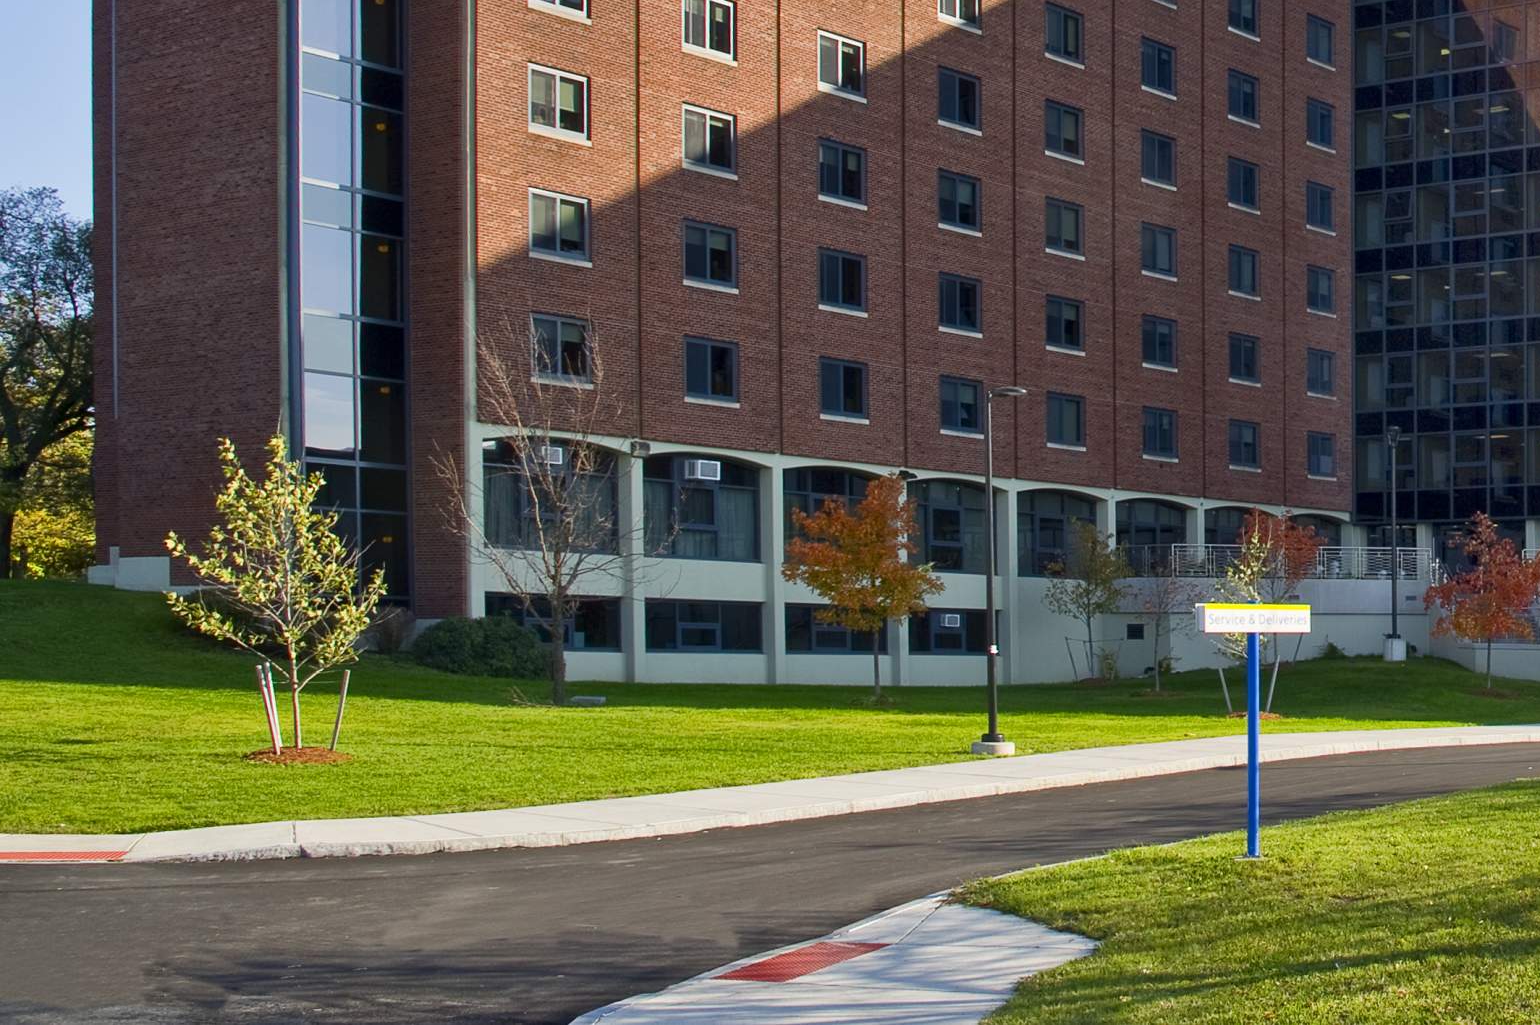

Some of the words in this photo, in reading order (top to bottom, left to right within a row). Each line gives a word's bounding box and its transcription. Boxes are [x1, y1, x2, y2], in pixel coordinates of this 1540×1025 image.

[1208, 614, 1245, 625] Service
[1248, 614, 1256, 625] &
[1259, 614, 1307, 625] Deliveries
